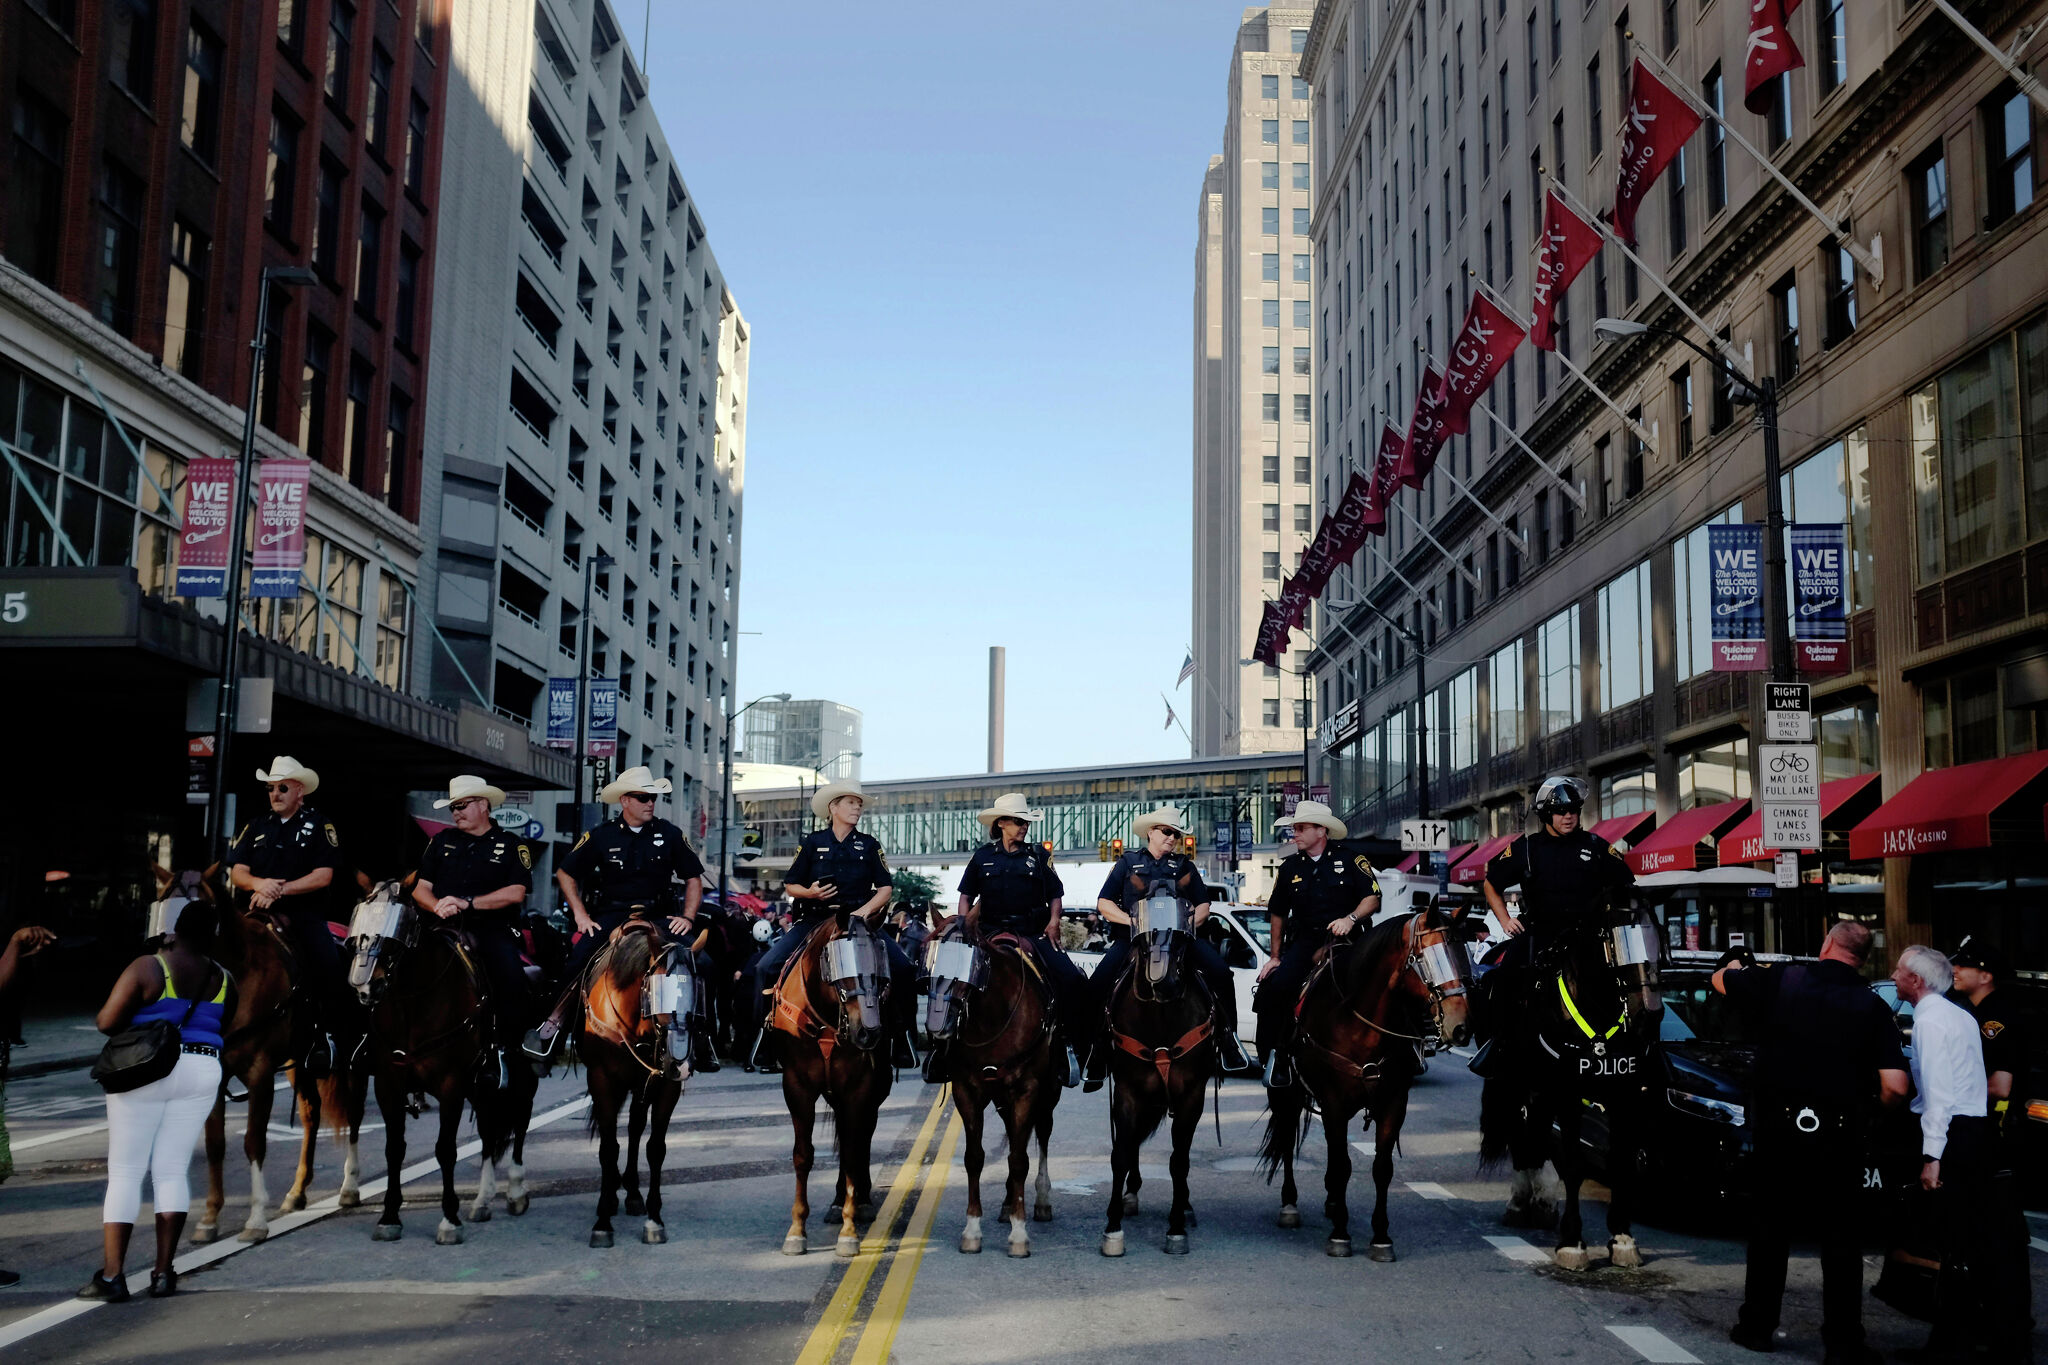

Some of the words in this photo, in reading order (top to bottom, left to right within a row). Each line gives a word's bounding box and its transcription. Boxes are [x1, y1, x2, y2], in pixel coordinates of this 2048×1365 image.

[1623, 145, 1655, 199] CASINO
[1463, 353, 1494, 395] CASINO
[191, 481, 229, 502] WE
[264, 482, 303, 502] WE
[188, 509, 227, 517] WELCOME
[262, 510, 301, 518] WELCOME
[187, 517, 210, 526] YOU
[211, 517, 226, 526] TO
[262, 518, 284, 527] YOU
[284, 518, 300, 527] TO
[1714, 549, 1758, 569] WE
[1798, 549, 1839, 569] WE
[1715, 570, 1731, 578] The
[1732, 570, 1757, 579] People
[1798, 570, 1814, 578] The
[1814, 570, 1838, 579] People
[1715, 578, 1758, 586] WELCOME
[1799, 578, 1839, 586] WELCOME
[1716, 586, 1740, 596] YOU
[1742, 586, 1758, 596] TO
[1800, 586, 1822, 596] YOU
[1823, 586, 1840, 596] TO
[1716, 596, 1758, 616] Cleveland
[1800, 596, 1840, 616] Cleveland
[1720, 645, 1757, 656] Quicken
[1804, 645, 1839, 656] Quicken
[1725, 653, 1754, 662] Loans
[1810, 653, 1835, 662] Loans
[551, 690, 574, 702] WE
[593, 691, 615, 703] WE
[1773, 687, 1802, 697] RIGHT
[1775, 699, 1801, 708] LANE
[1776, 712, 1800, 720] BUSES
[485, 727, 505, 751] 2025
[1770, 775, 1787, 784] MAY
[1791, 775, 1809, 784] USE
[1765, 786, 1788, 795] FULL
[1792, 786, 1815, 795] LANE
[1773, 808, 1809, 818] CHANGE
[1776, 821, 1807, 830] LANES
[1773, 833, 1784, 841] TO
[1789, 833, 1812, 841] PASS
[1917, 829, 1948, 844] CASINO
[1579, 1056, 1636, 1075] POLICE
